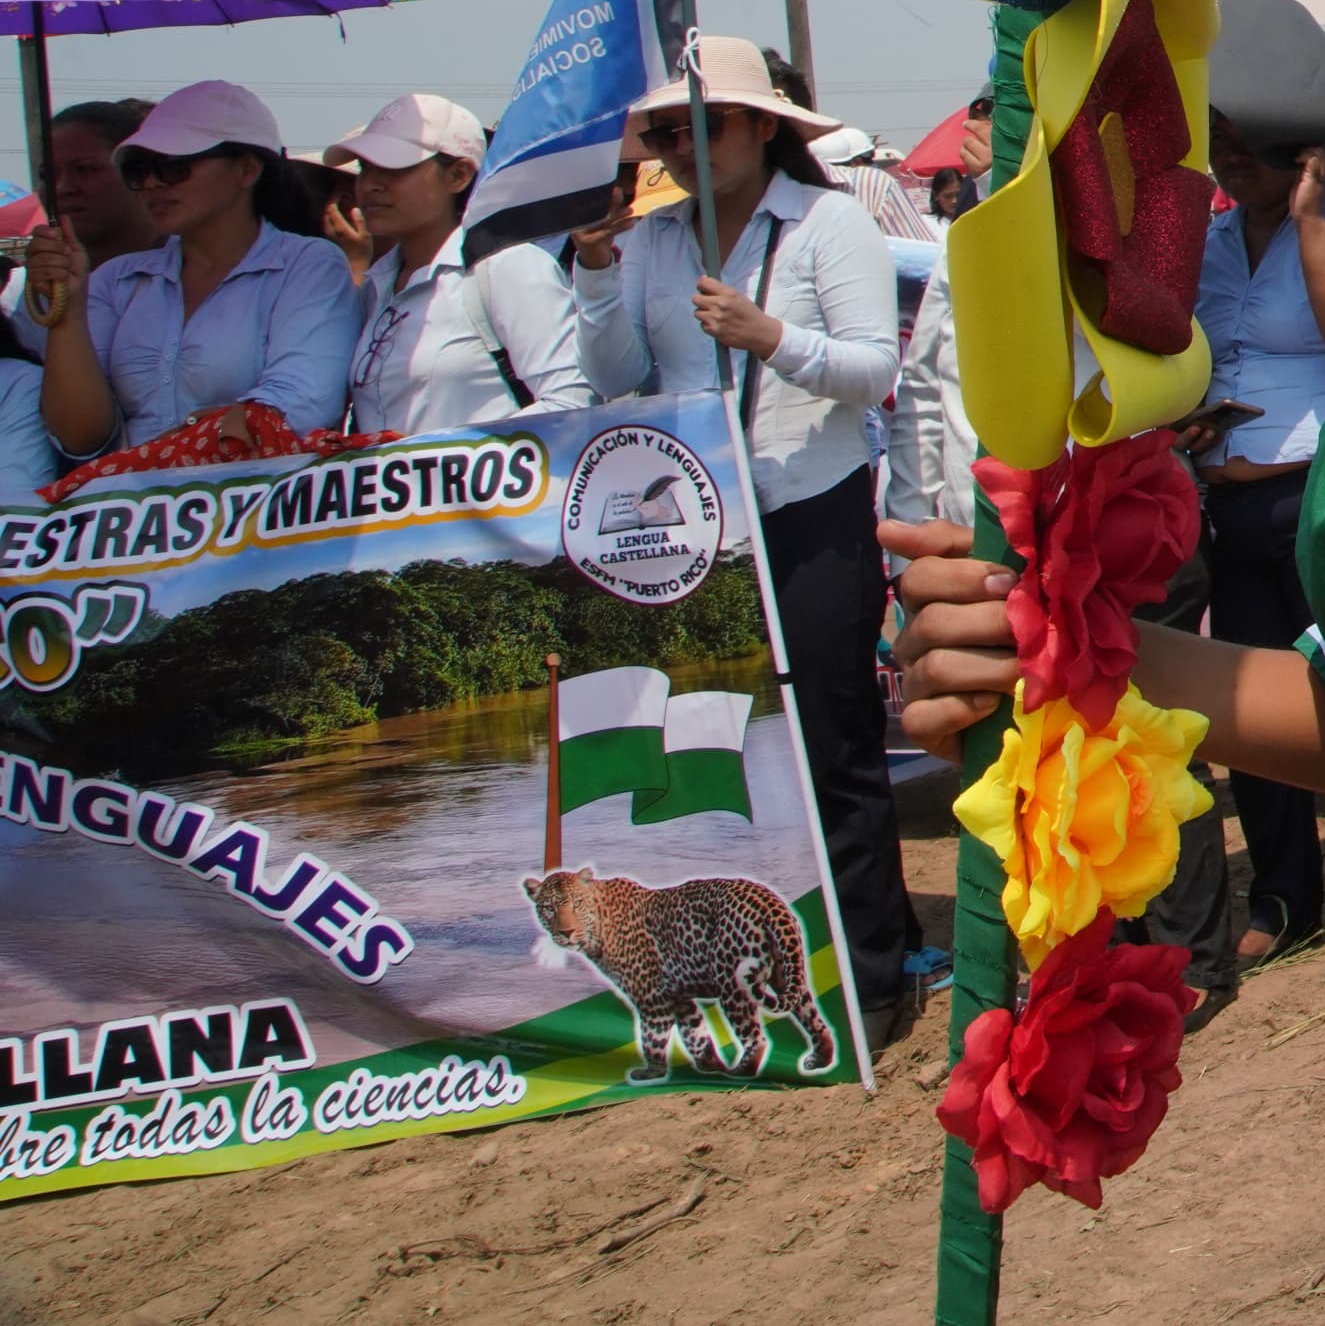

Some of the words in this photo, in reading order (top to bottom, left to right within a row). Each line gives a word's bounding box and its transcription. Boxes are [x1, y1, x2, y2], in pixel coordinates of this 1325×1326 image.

[223, 490, 266, 540] Y
[266, 447, 537, 532] MAESTROS
[567, 430, 640, 531] COMUNICACIÓN
[643, 433, 655, 447] Y
[657, 438, 716, 522] LENGUAJES
[580, 558, 617, 586] ESFM
[600, 544, 692, 564] CASTELLANA
[617, 531, 671, 549] LENGUA
[0, 757, 406, 978] NGUAJES
[93, 1098, 228, 1158] todas
[250, 1079, 300, 1136] la
[320, 1060, 523, 1125] ciencias.
